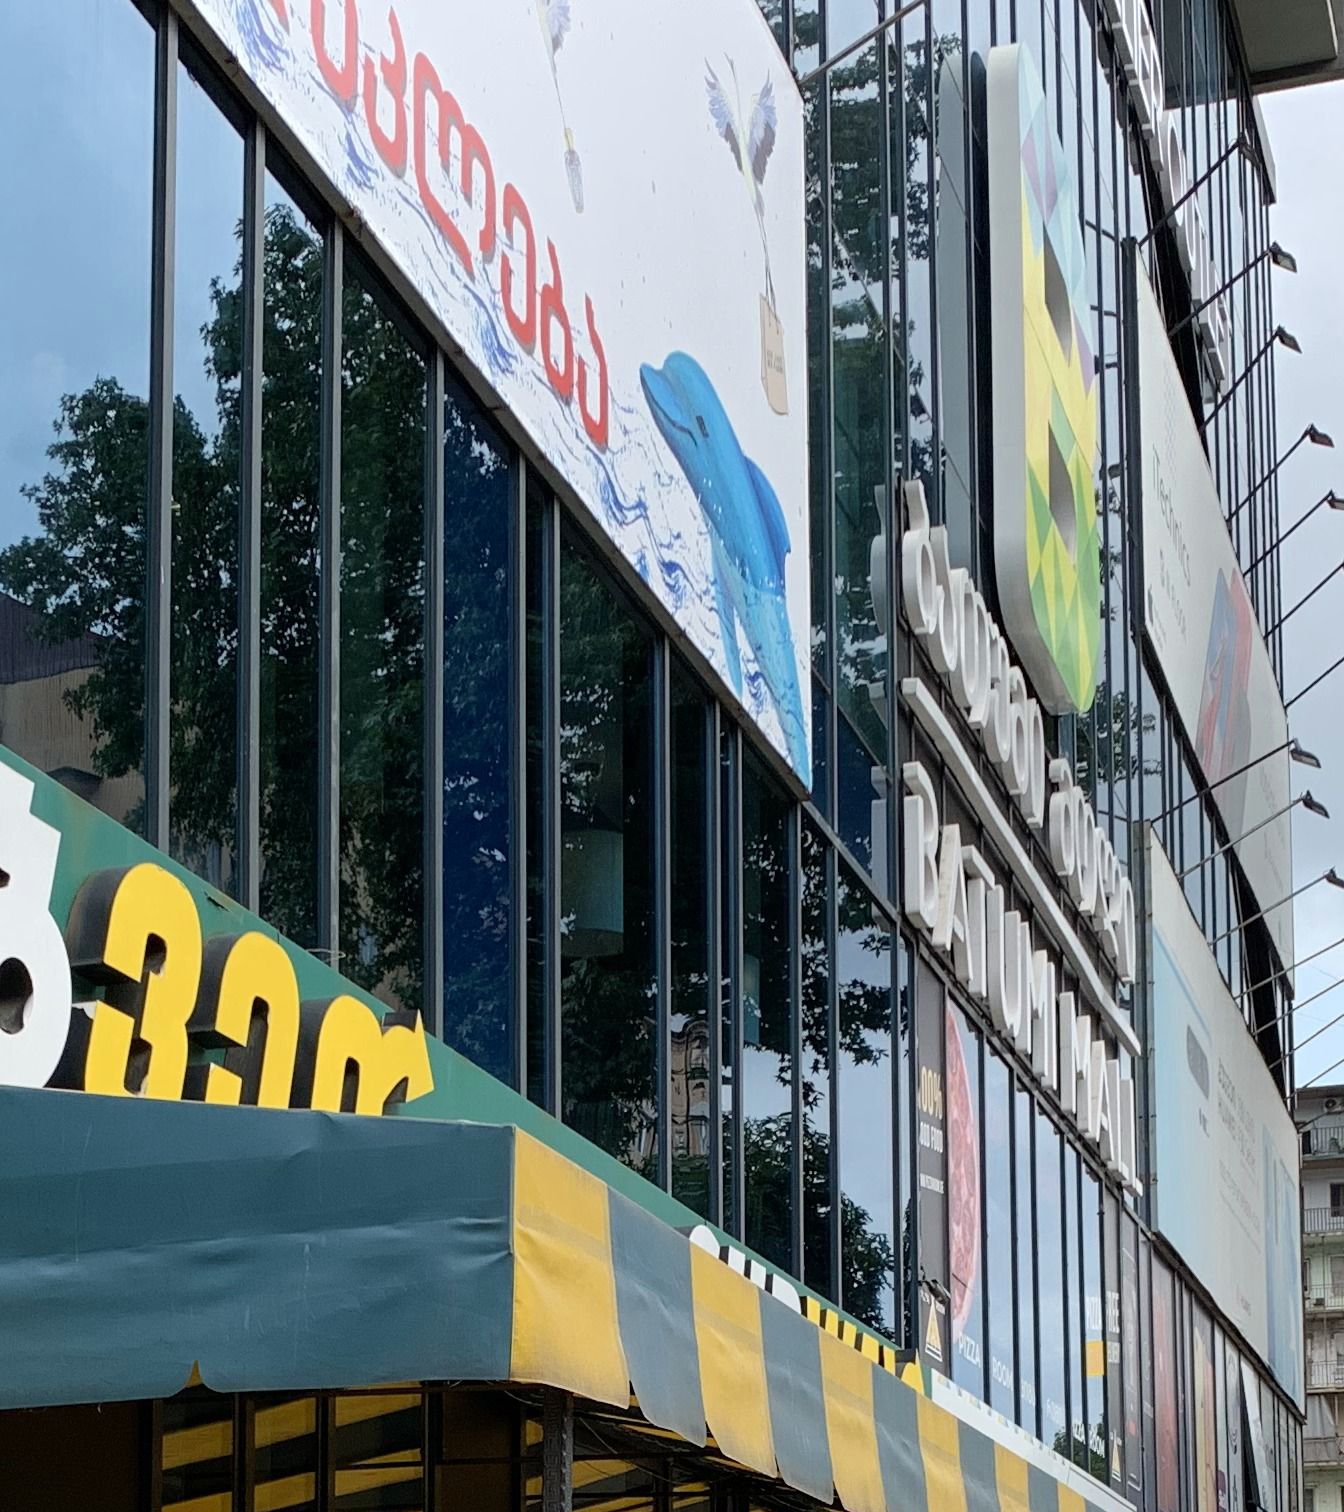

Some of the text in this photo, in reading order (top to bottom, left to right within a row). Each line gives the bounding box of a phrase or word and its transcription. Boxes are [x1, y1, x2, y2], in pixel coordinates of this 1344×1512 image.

[904, 761, 1143, 1197] BATUMI MALL
[919, 1065, 943, 1121] 00%
[958, 1335, 1014, 1391] PIZZA ROOM
